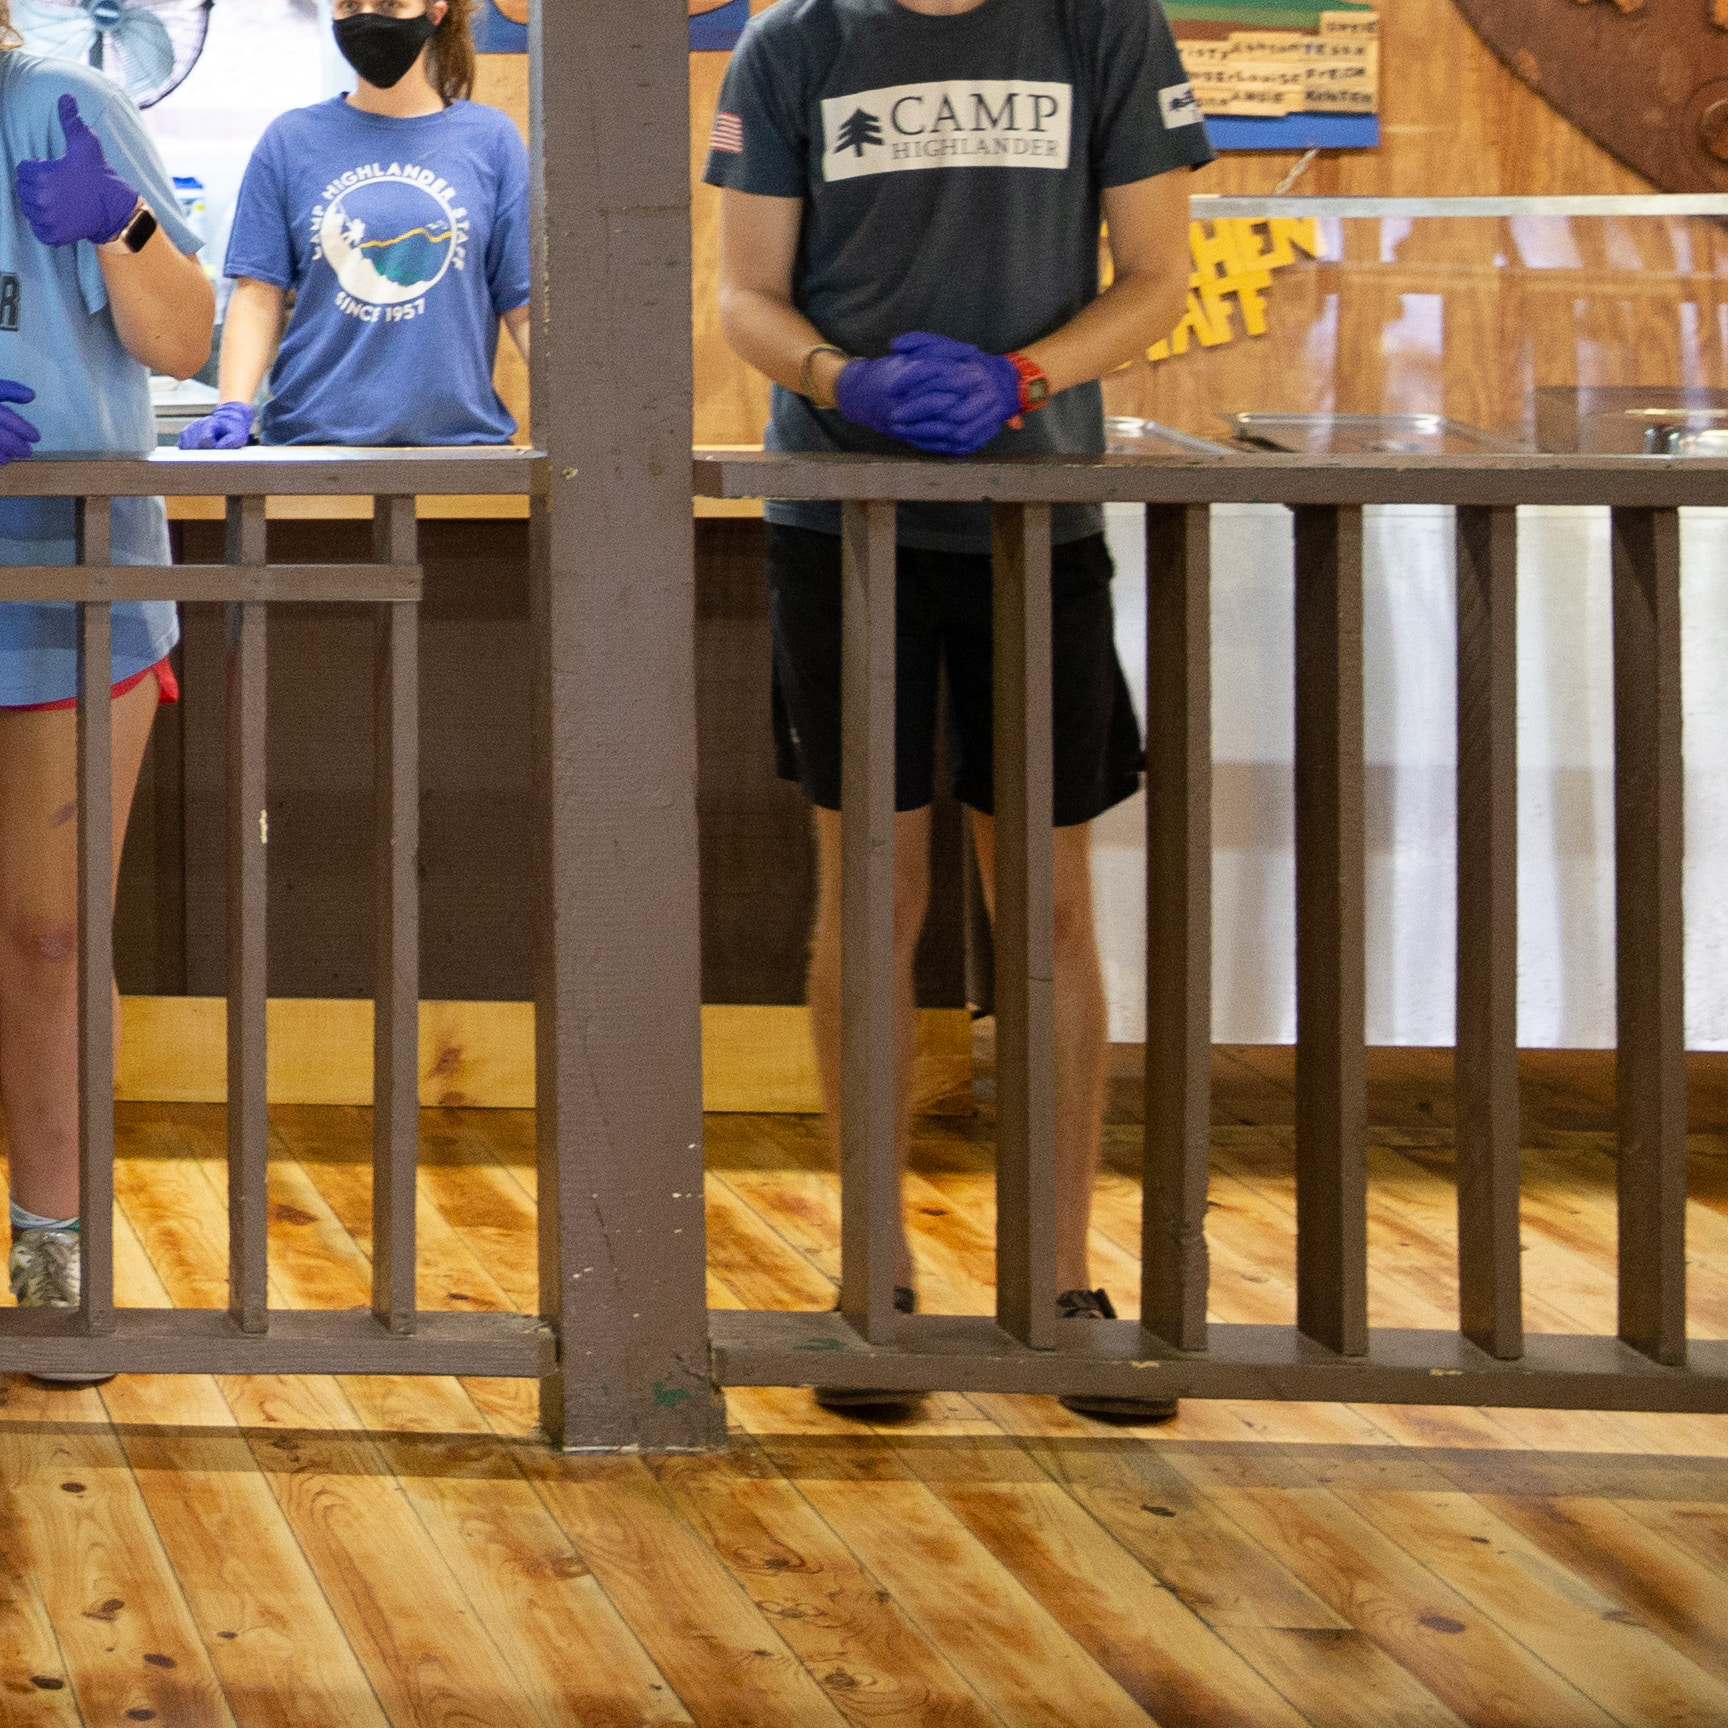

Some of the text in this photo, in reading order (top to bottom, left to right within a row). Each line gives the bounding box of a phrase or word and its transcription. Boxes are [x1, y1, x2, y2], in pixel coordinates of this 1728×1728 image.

[890, 92, 1059, 135] CAMP
[892, 137, 1060, 159] HIGHLANDER
[321, 162, 457, 202] HIGHLANDER
[334, 291, 426, 323] SINCE 1957
